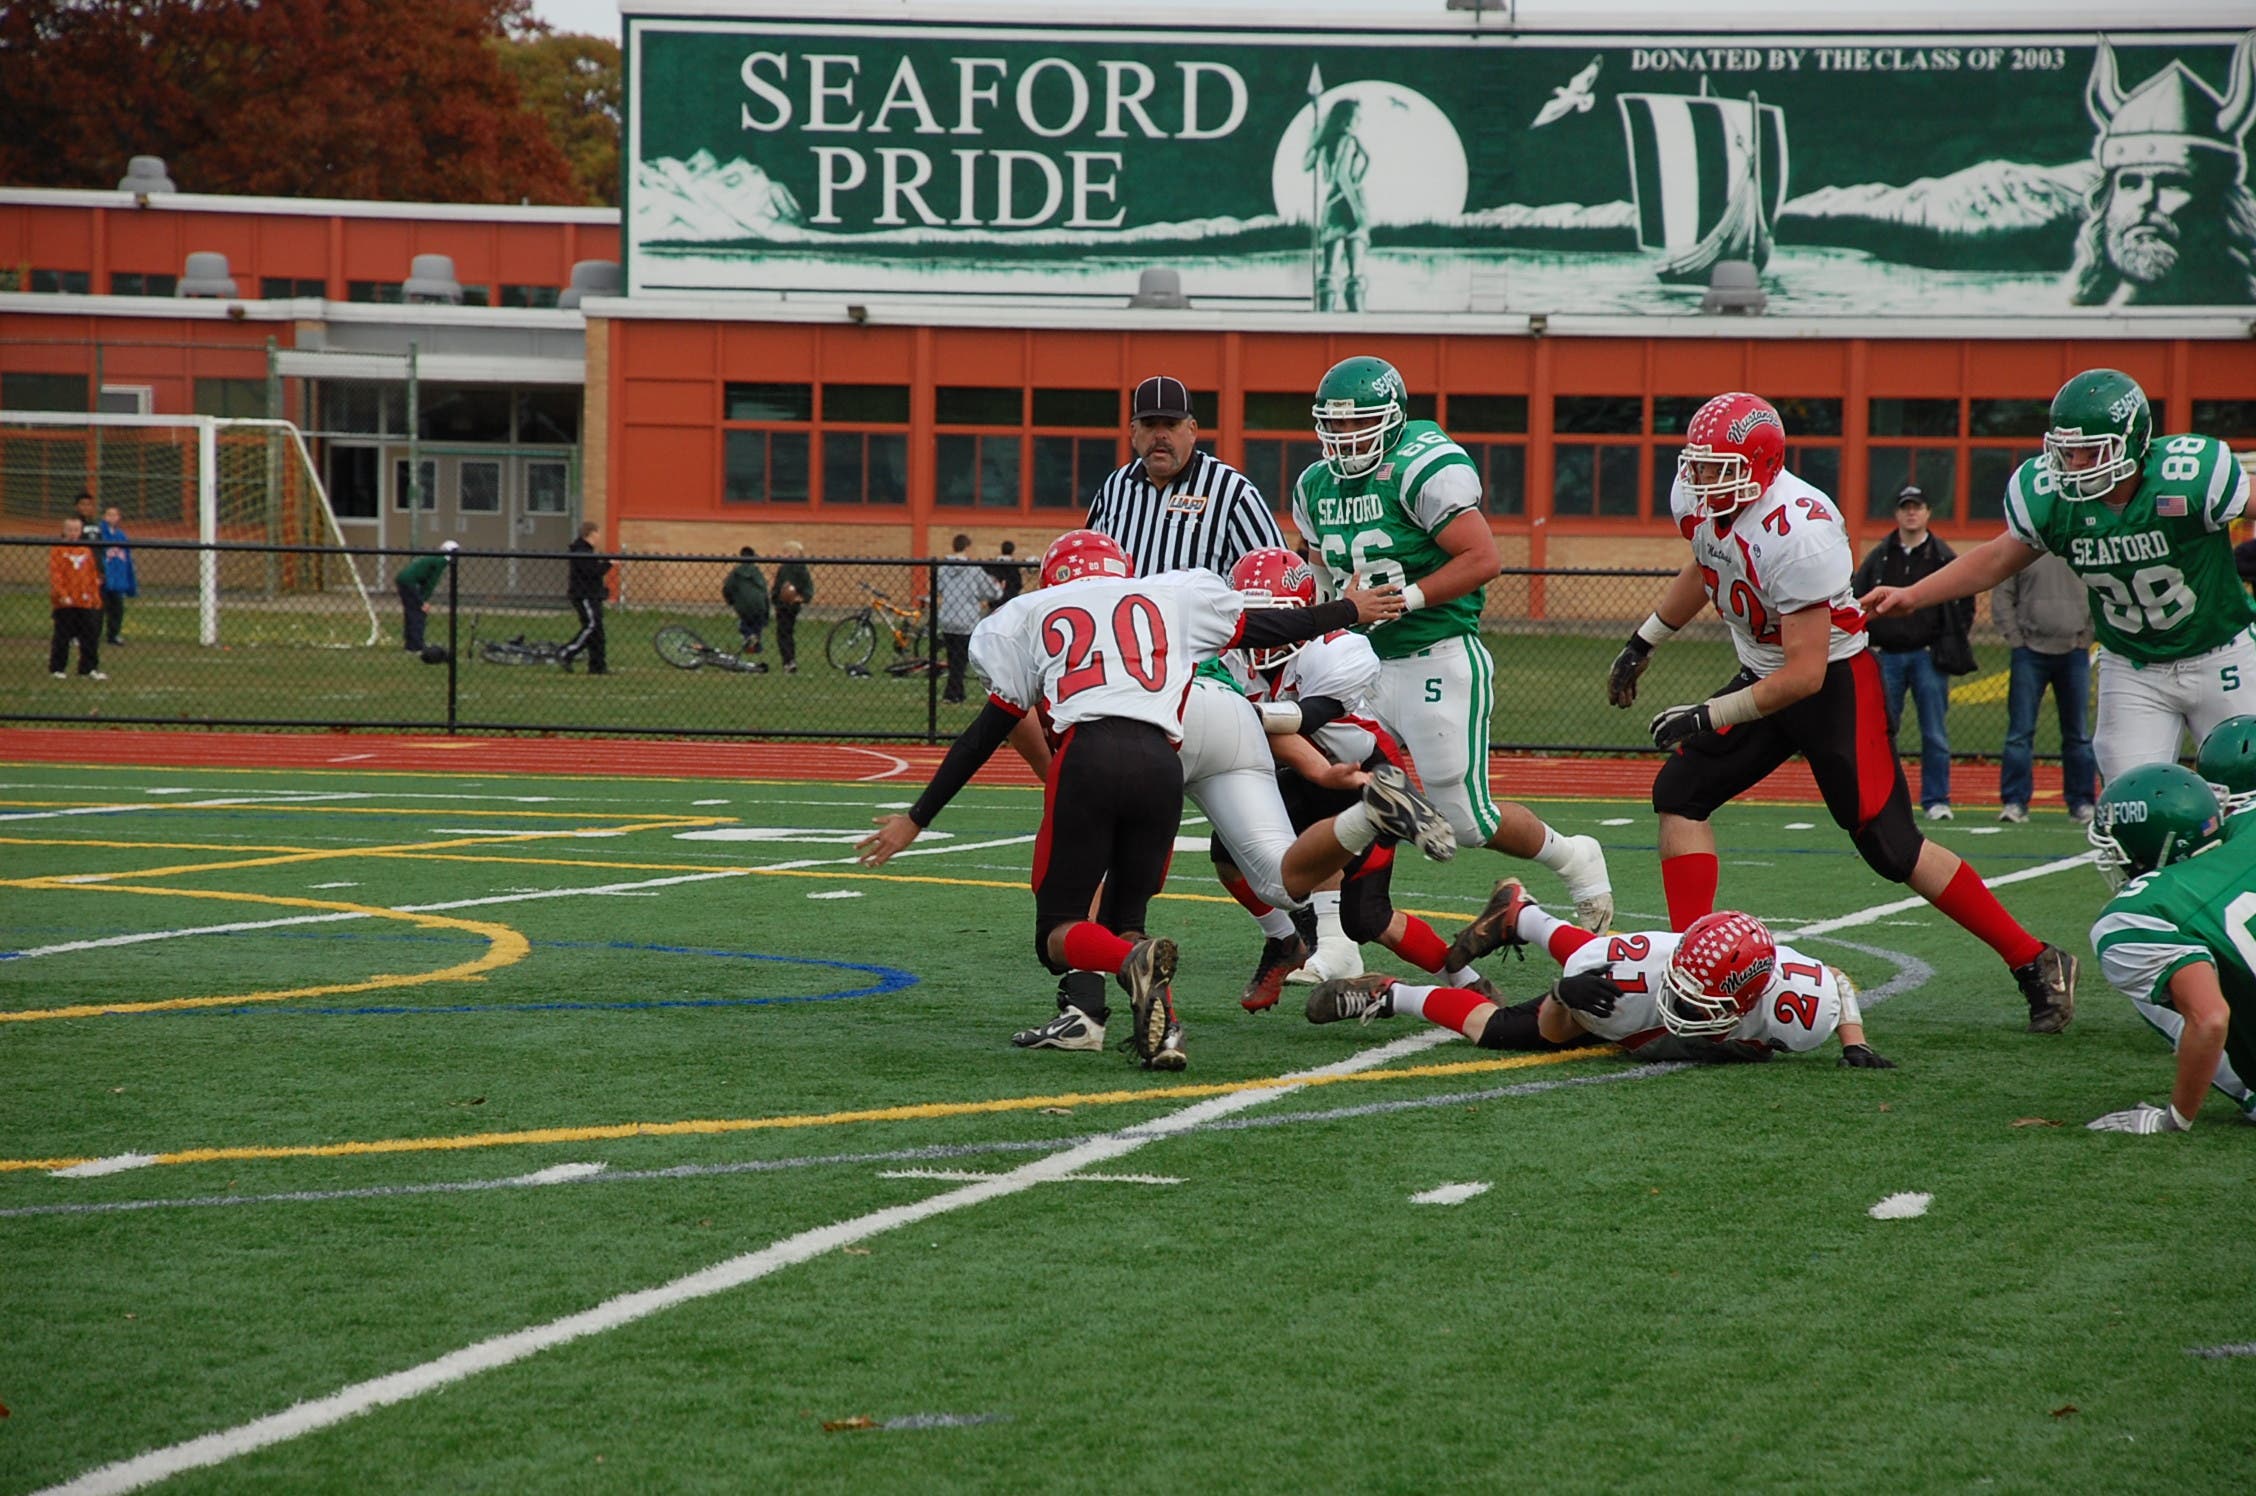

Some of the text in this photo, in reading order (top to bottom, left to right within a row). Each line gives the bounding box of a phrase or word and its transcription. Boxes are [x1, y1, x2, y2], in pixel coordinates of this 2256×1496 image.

[1631, 48, 2067, 71] DONATED BY THE CLASS OF 2003
[740, 50, 1248, 139] SEAFORD
[808, 146, 1128, 229] PRIDE
[1396, 430, 1448, 458] 66
[2161, 435, 2207, 481] 88
[1317, 493, 1384, 526] SEAFORD
[1761, 497, 1833, 537] 72
[1320, 527, 1407, 612] 66
[2071, 530, 2170, 566] SEAFORD
[1697, 564, 1783, 646] 72
[1042, 593, 1169, 705] 20
[1424, 678, 1442, 703] S
[2219, 665, 2241, 692] S
[2096, 800, 2148, 827] SEFORD
[1606, 934, 1651, 994] 21
[1774, 961, 1823, 1031] 21
